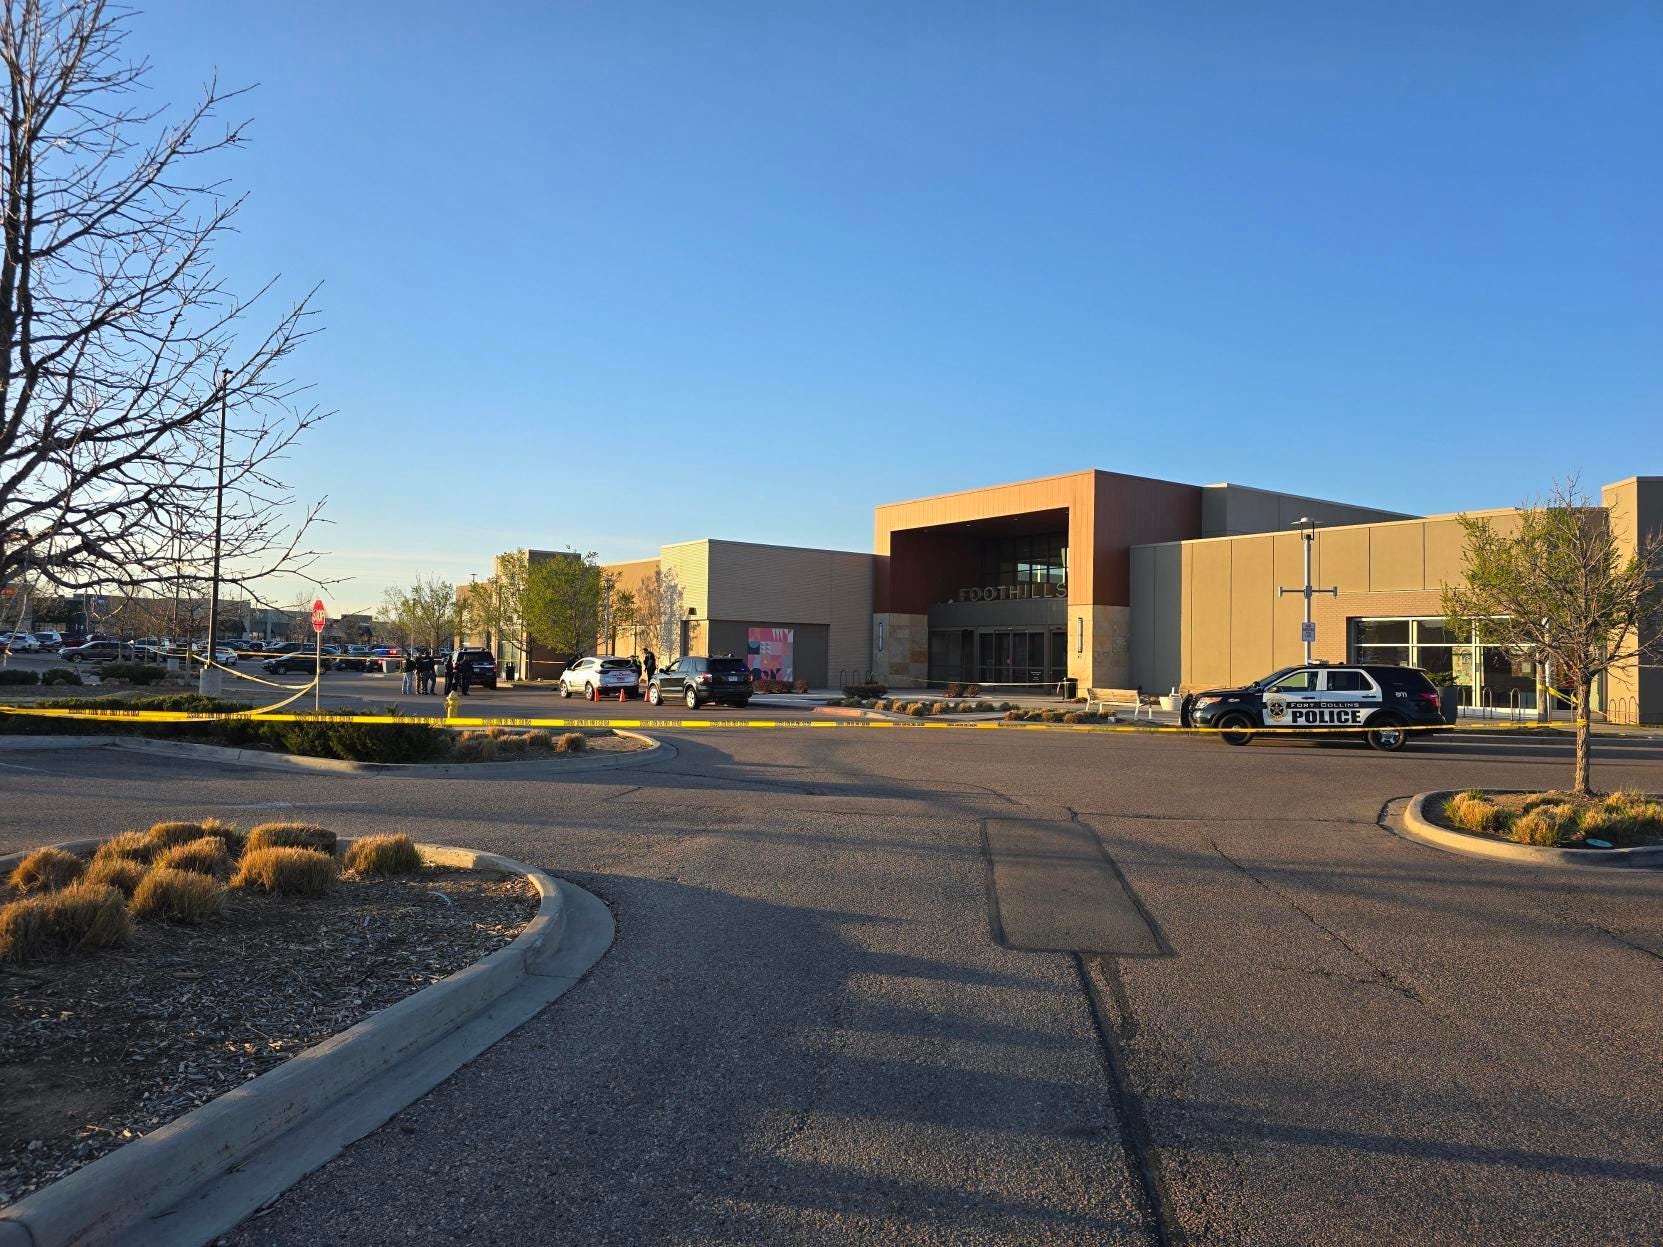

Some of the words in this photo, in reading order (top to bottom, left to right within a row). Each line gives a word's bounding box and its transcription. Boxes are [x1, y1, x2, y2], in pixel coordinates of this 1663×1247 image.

[959, 582, 1068, 602] FOOTHILLS
[312, 609, 325, 622] STOP
[1291, 709, 1362, 724] POLICE
